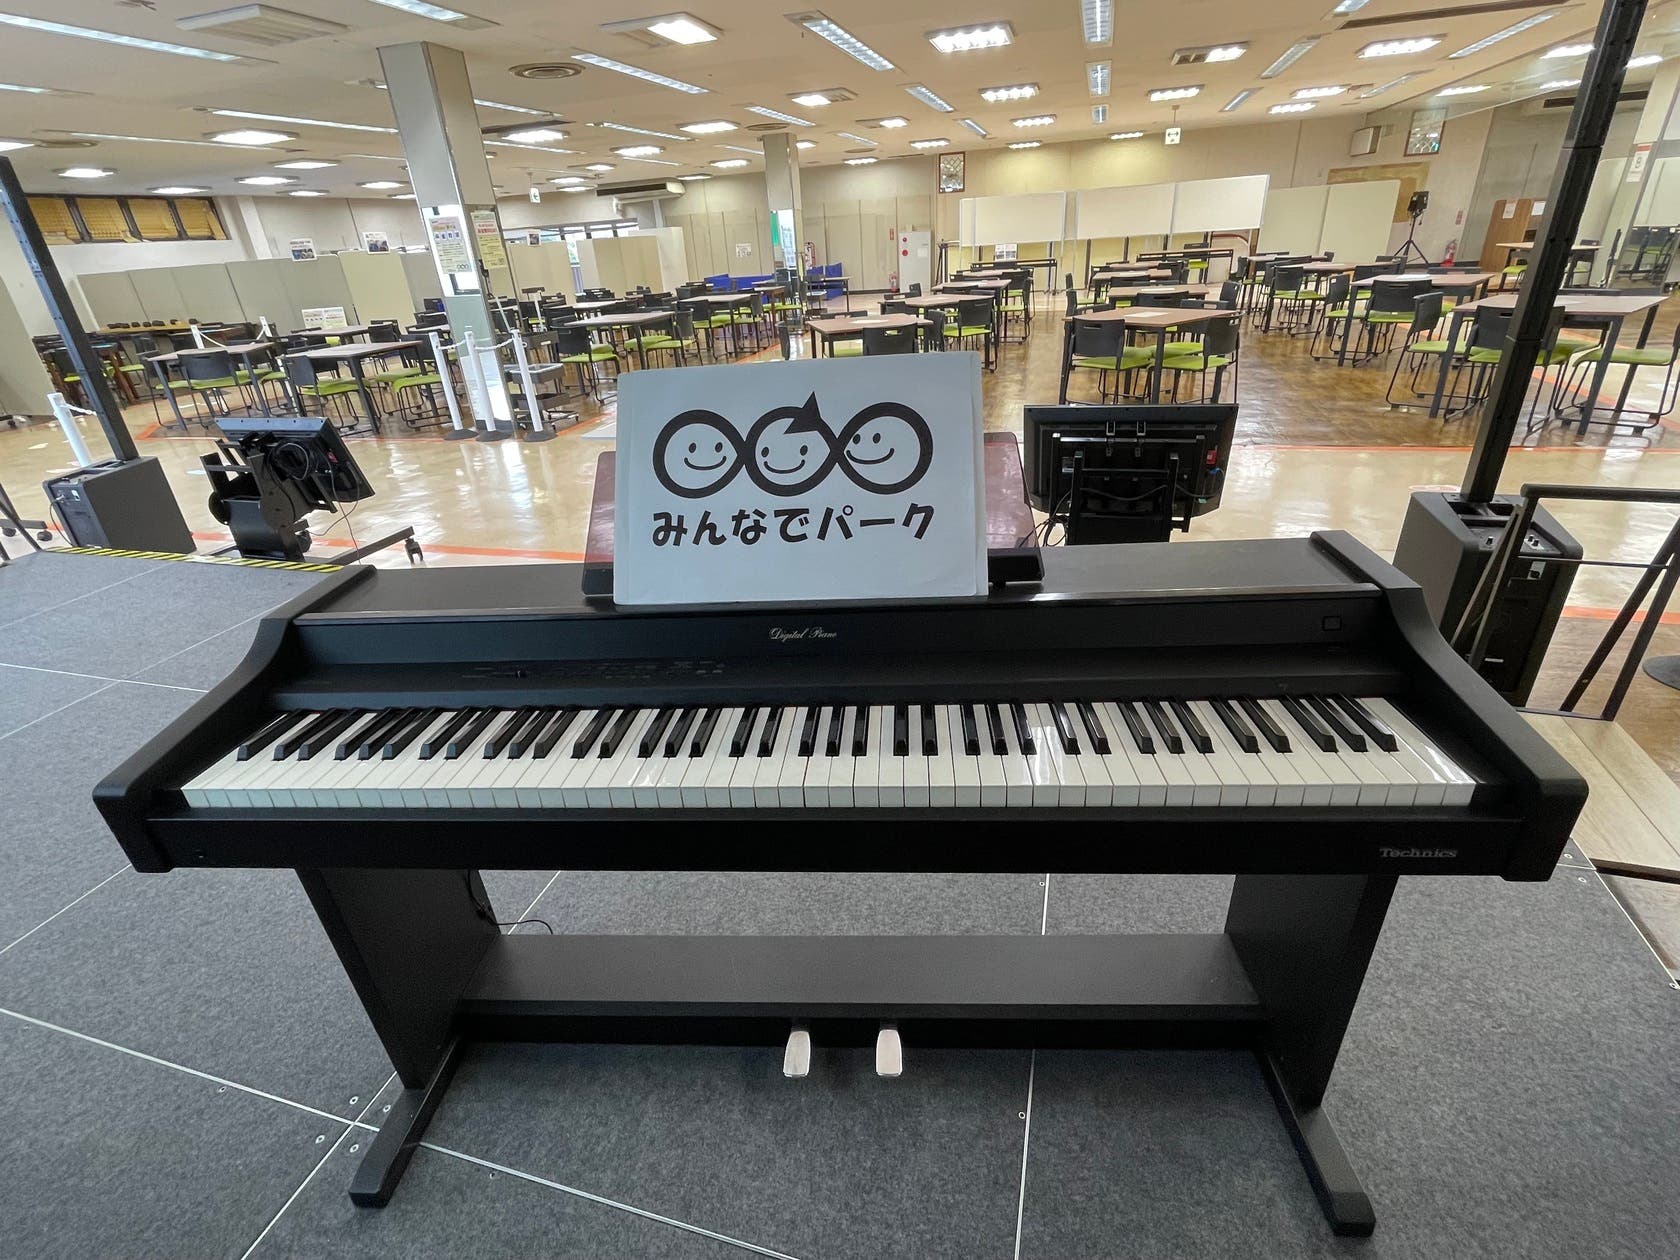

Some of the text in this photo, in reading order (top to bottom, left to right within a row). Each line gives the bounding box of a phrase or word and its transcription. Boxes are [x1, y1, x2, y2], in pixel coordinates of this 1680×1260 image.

[652, 503, 935, 547] みんなでパーク
[769, 626, 837, 643] Digital Piano
[1380, 847, 1457, 858] Technics
